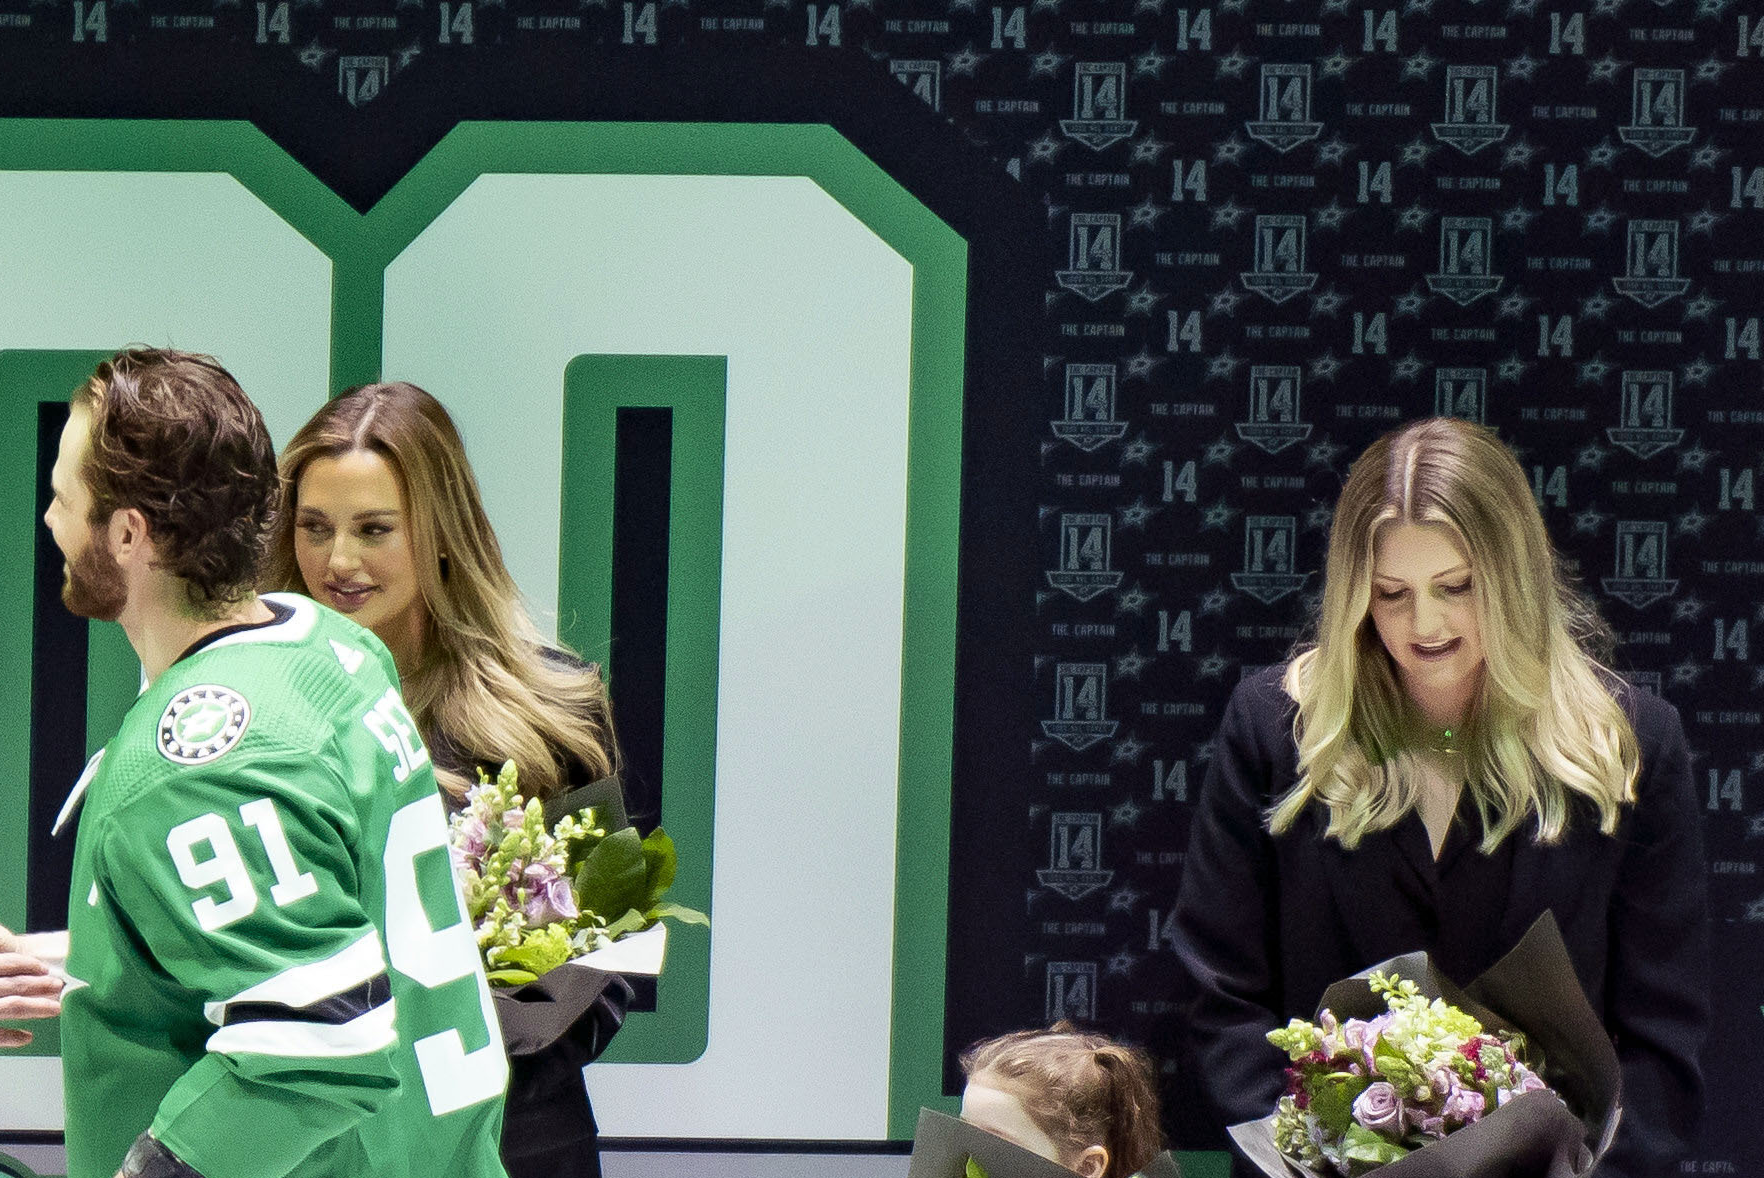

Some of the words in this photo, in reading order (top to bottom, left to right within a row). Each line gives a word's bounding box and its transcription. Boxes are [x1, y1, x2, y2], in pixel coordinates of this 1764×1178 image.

[255, 2, 290, 43] 14
[439, 3, 474, 44] 14
[622, 3, 657, 44] 14
[806, 5, 841, 46] 14
[991, 8, 1026, 50] 14
[1177, 9, 1212, 51] 14
[1363, 10, 1398, 52] 14
[1549, 13, 1584, 55] 14
[1453, 80, 1487, 121] 14
[1172, 160, 1207, 202] 14
[1357, 162, 1392, 204] 14
[1544, 164, 1579, 206] 14
[1077, 227, 1111, 268] 14
[1167, 311, 1202, 353] 14
[1352, 313, 1387, 355] 14
[1538, 315, 1573, 357] 14
[1722, 318, 1757, 359] 14
[1162, 461, 1197, 503] 14
[1719, 469, 1754, 511] 14
[1068, 527, 1102, 568] 14
[1623, 535, 1657, 576] 14
[1157, 611, 1192, 653] 14
[1713, 619, 1748, 661] 14
[1152, 760, 1187, 802] 14
[1708, 769, 1743, 811] 14
[165, 797, 319, 933] 91
[1058, 826, 1092, 867] 14
[382, 791, 512, 1117] 9
